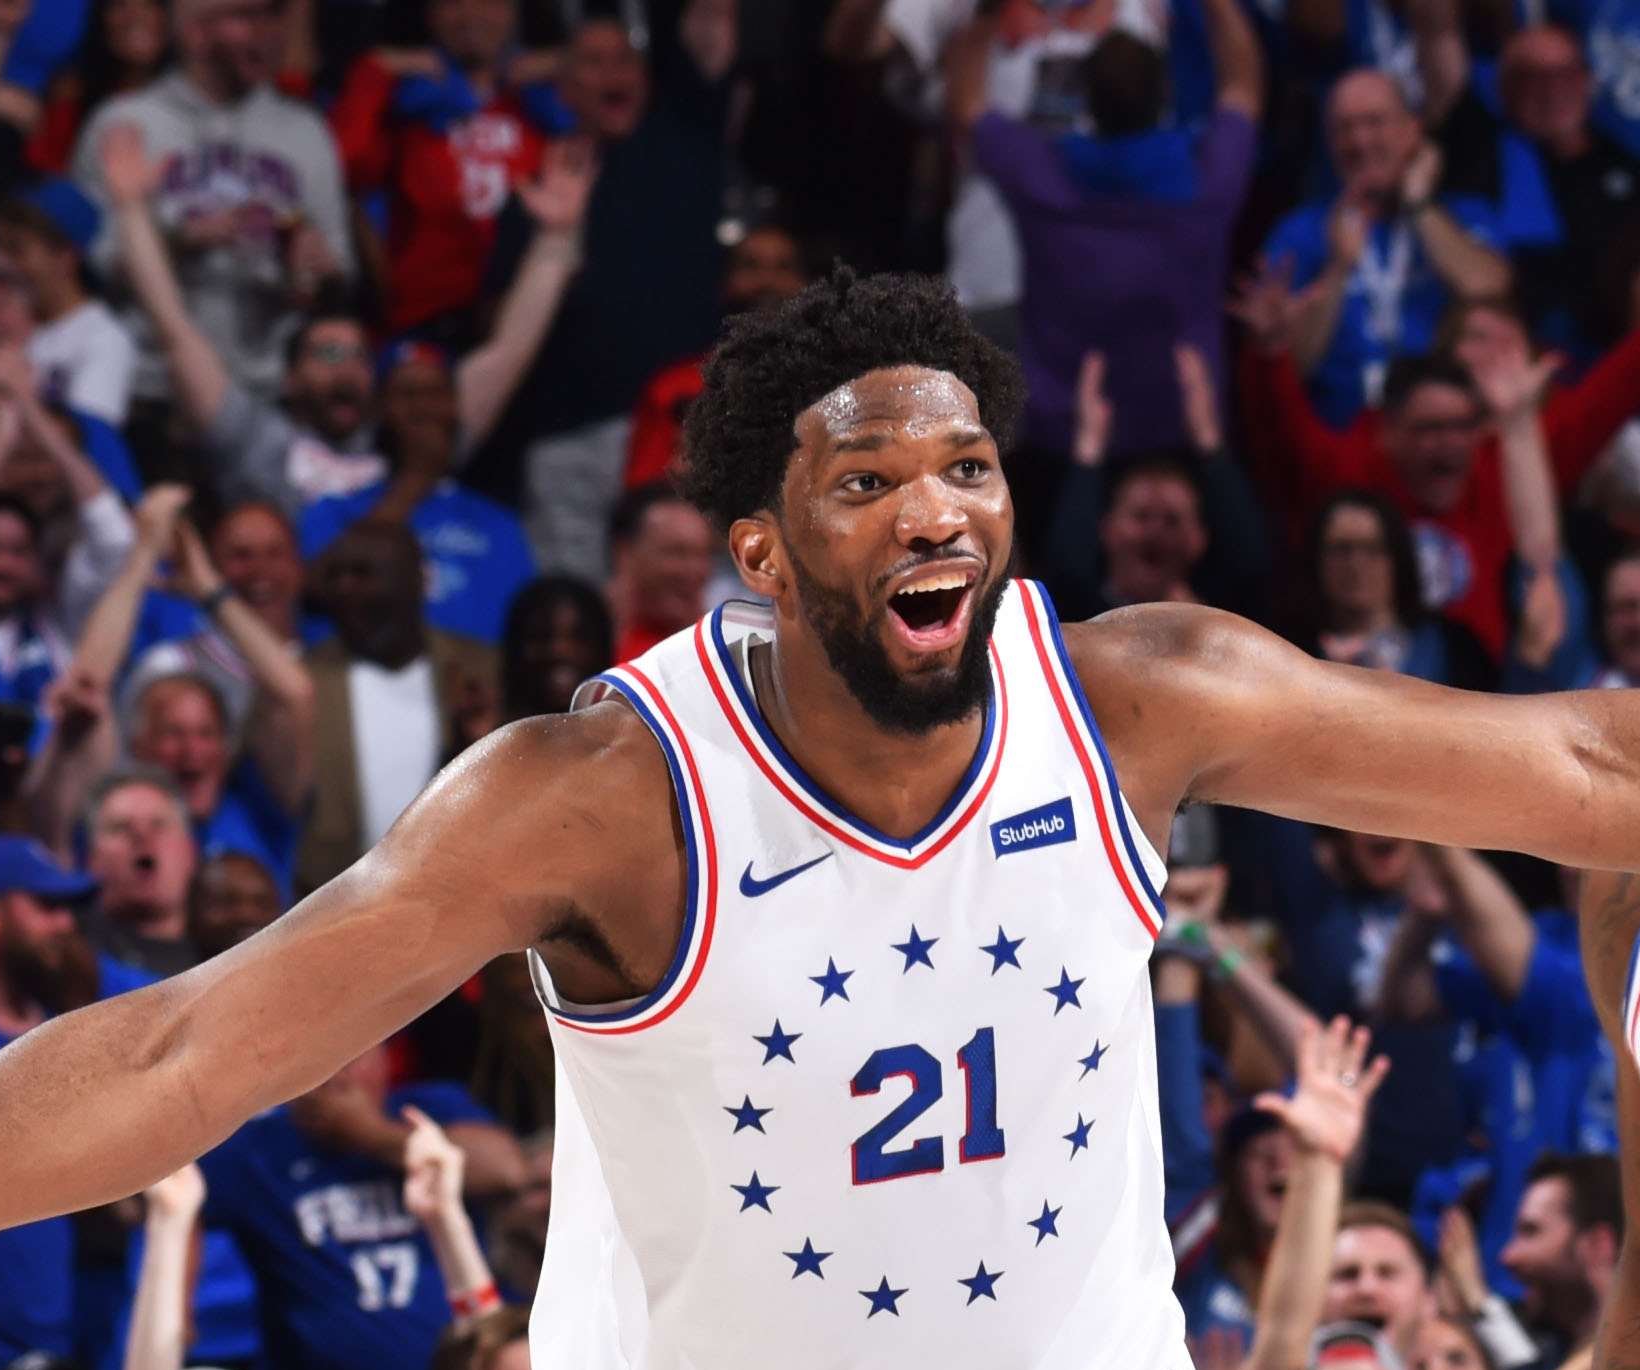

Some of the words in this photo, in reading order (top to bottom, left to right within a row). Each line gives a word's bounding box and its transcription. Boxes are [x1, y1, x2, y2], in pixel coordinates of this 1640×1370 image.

[999, 814, 1065, 846] StubHub
[850, 1026, 1006, 1186] 21
[295, 1182, 422, 1246] PHIL
[352, 1245, 418, 1311] 17
